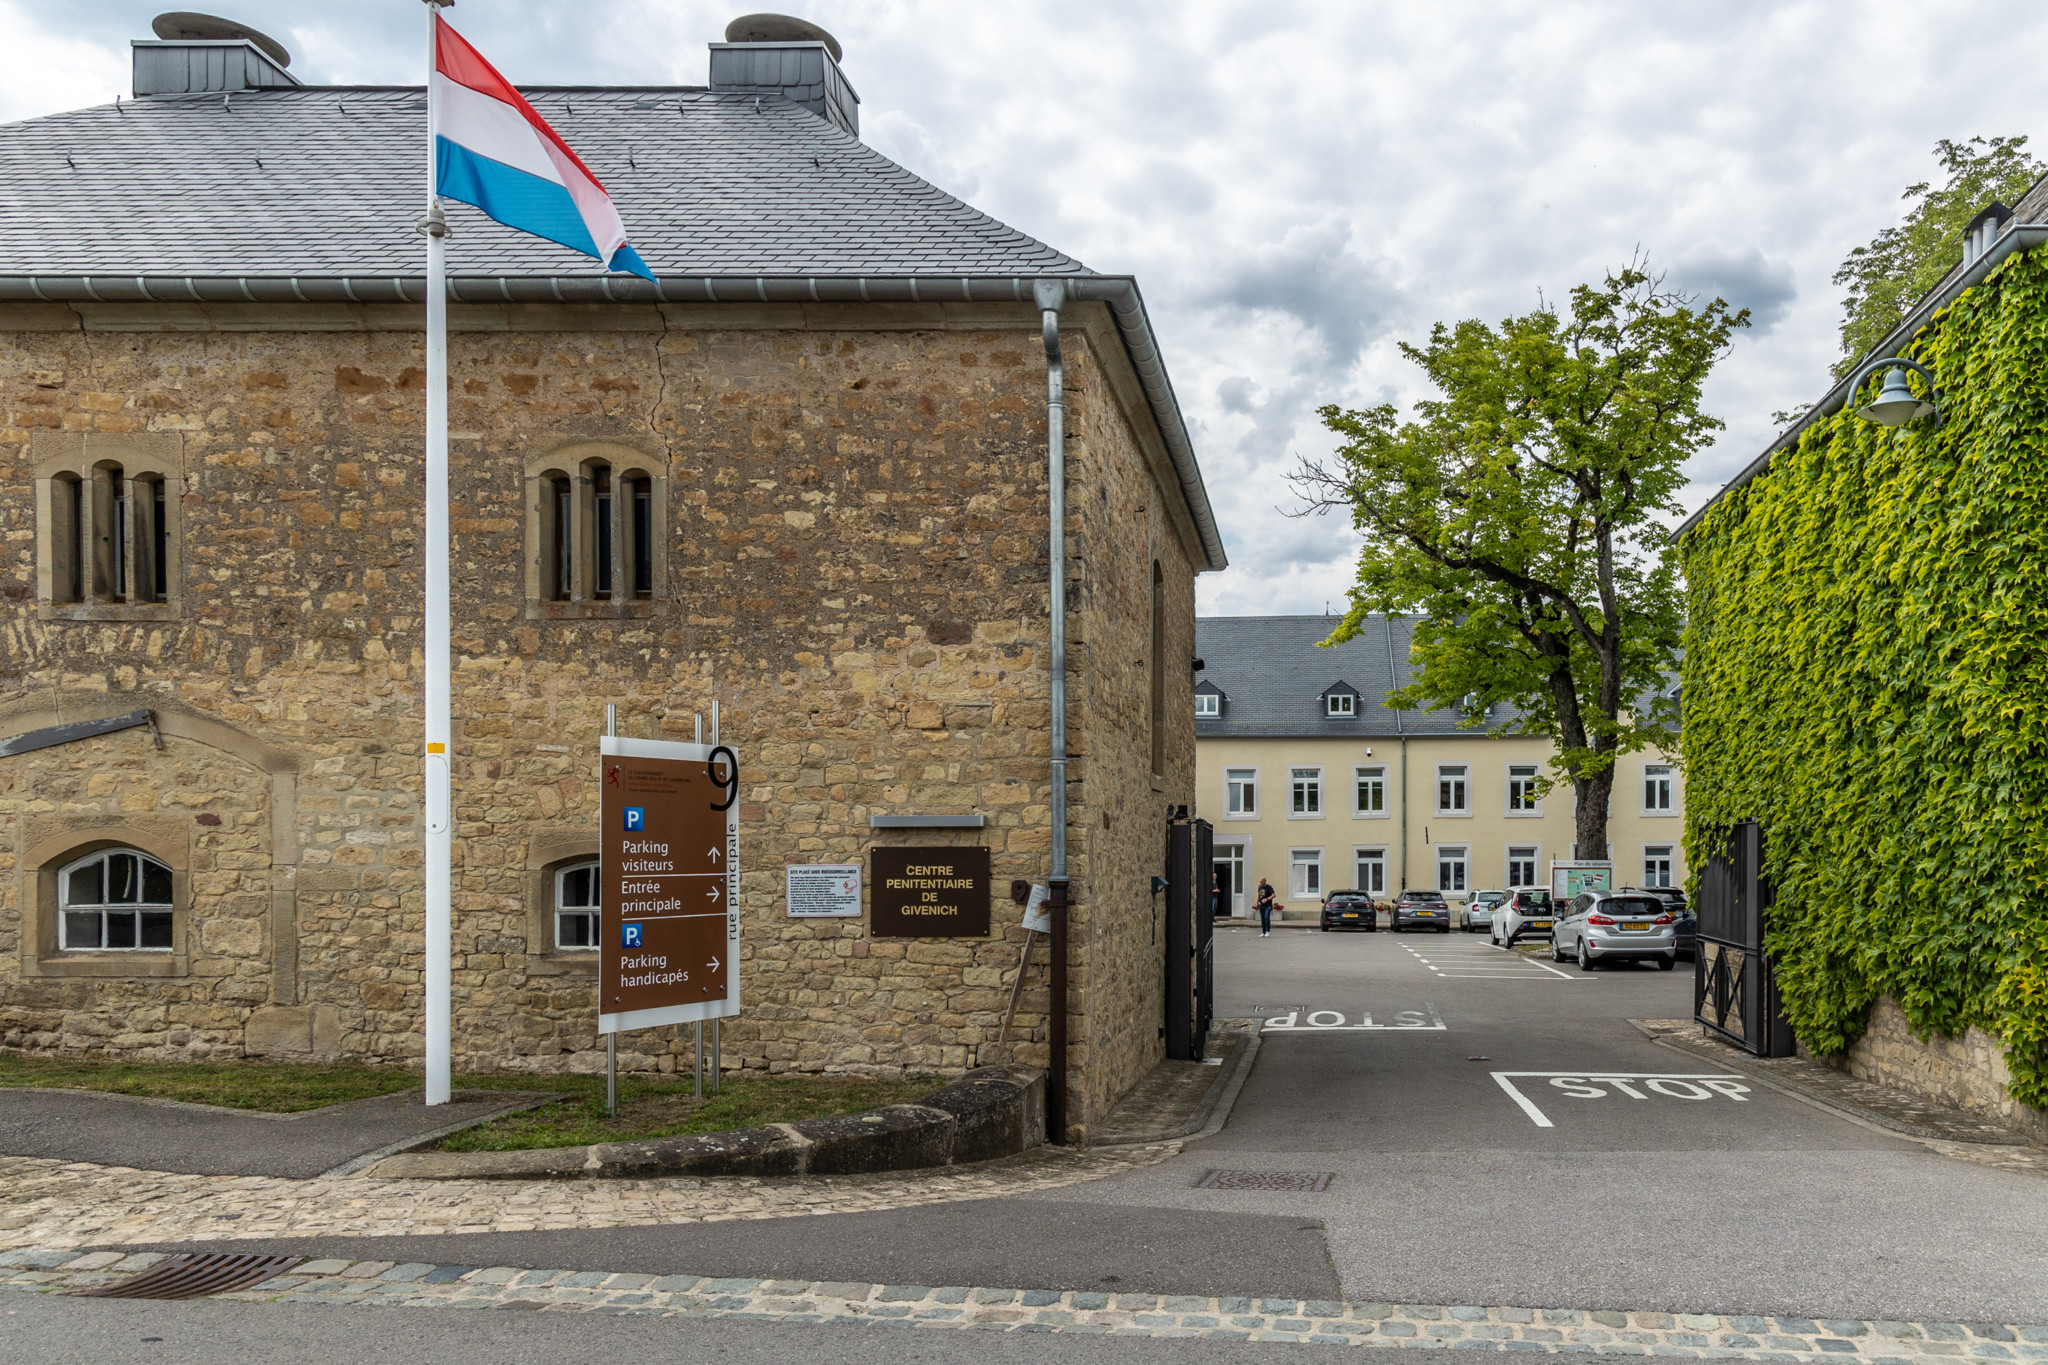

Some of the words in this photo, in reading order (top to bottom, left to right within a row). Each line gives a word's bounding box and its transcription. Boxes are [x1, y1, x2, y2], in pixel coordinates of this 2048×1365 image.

[708, 746, 738, 811] 9
[627, 811, 639, 828] P
[622, 840, 668, 856] Parking
[622, 859, 674, 871] visiteurs
[726, 823, 738, 907] principale
[906, 866, 954, 876] CENTRE
[621, 880, 661, 894] Entrée
[886, 879, 973, 889] PENITENTIAIRE
[922, 892, 938, 902] DE
[621, 897, 681, 915] principale
[901, 905, 958, 916] GIVENICH
[729, 913, 737, 940] rue
[626, 928, 638, 945] P
[621, 954, 667, 970] Parking
[620, 969, 689, 987] handicapés
[1264, 1011, 1427, 1027] STOP
[1549, 1077, 1752, 1101] STOP
